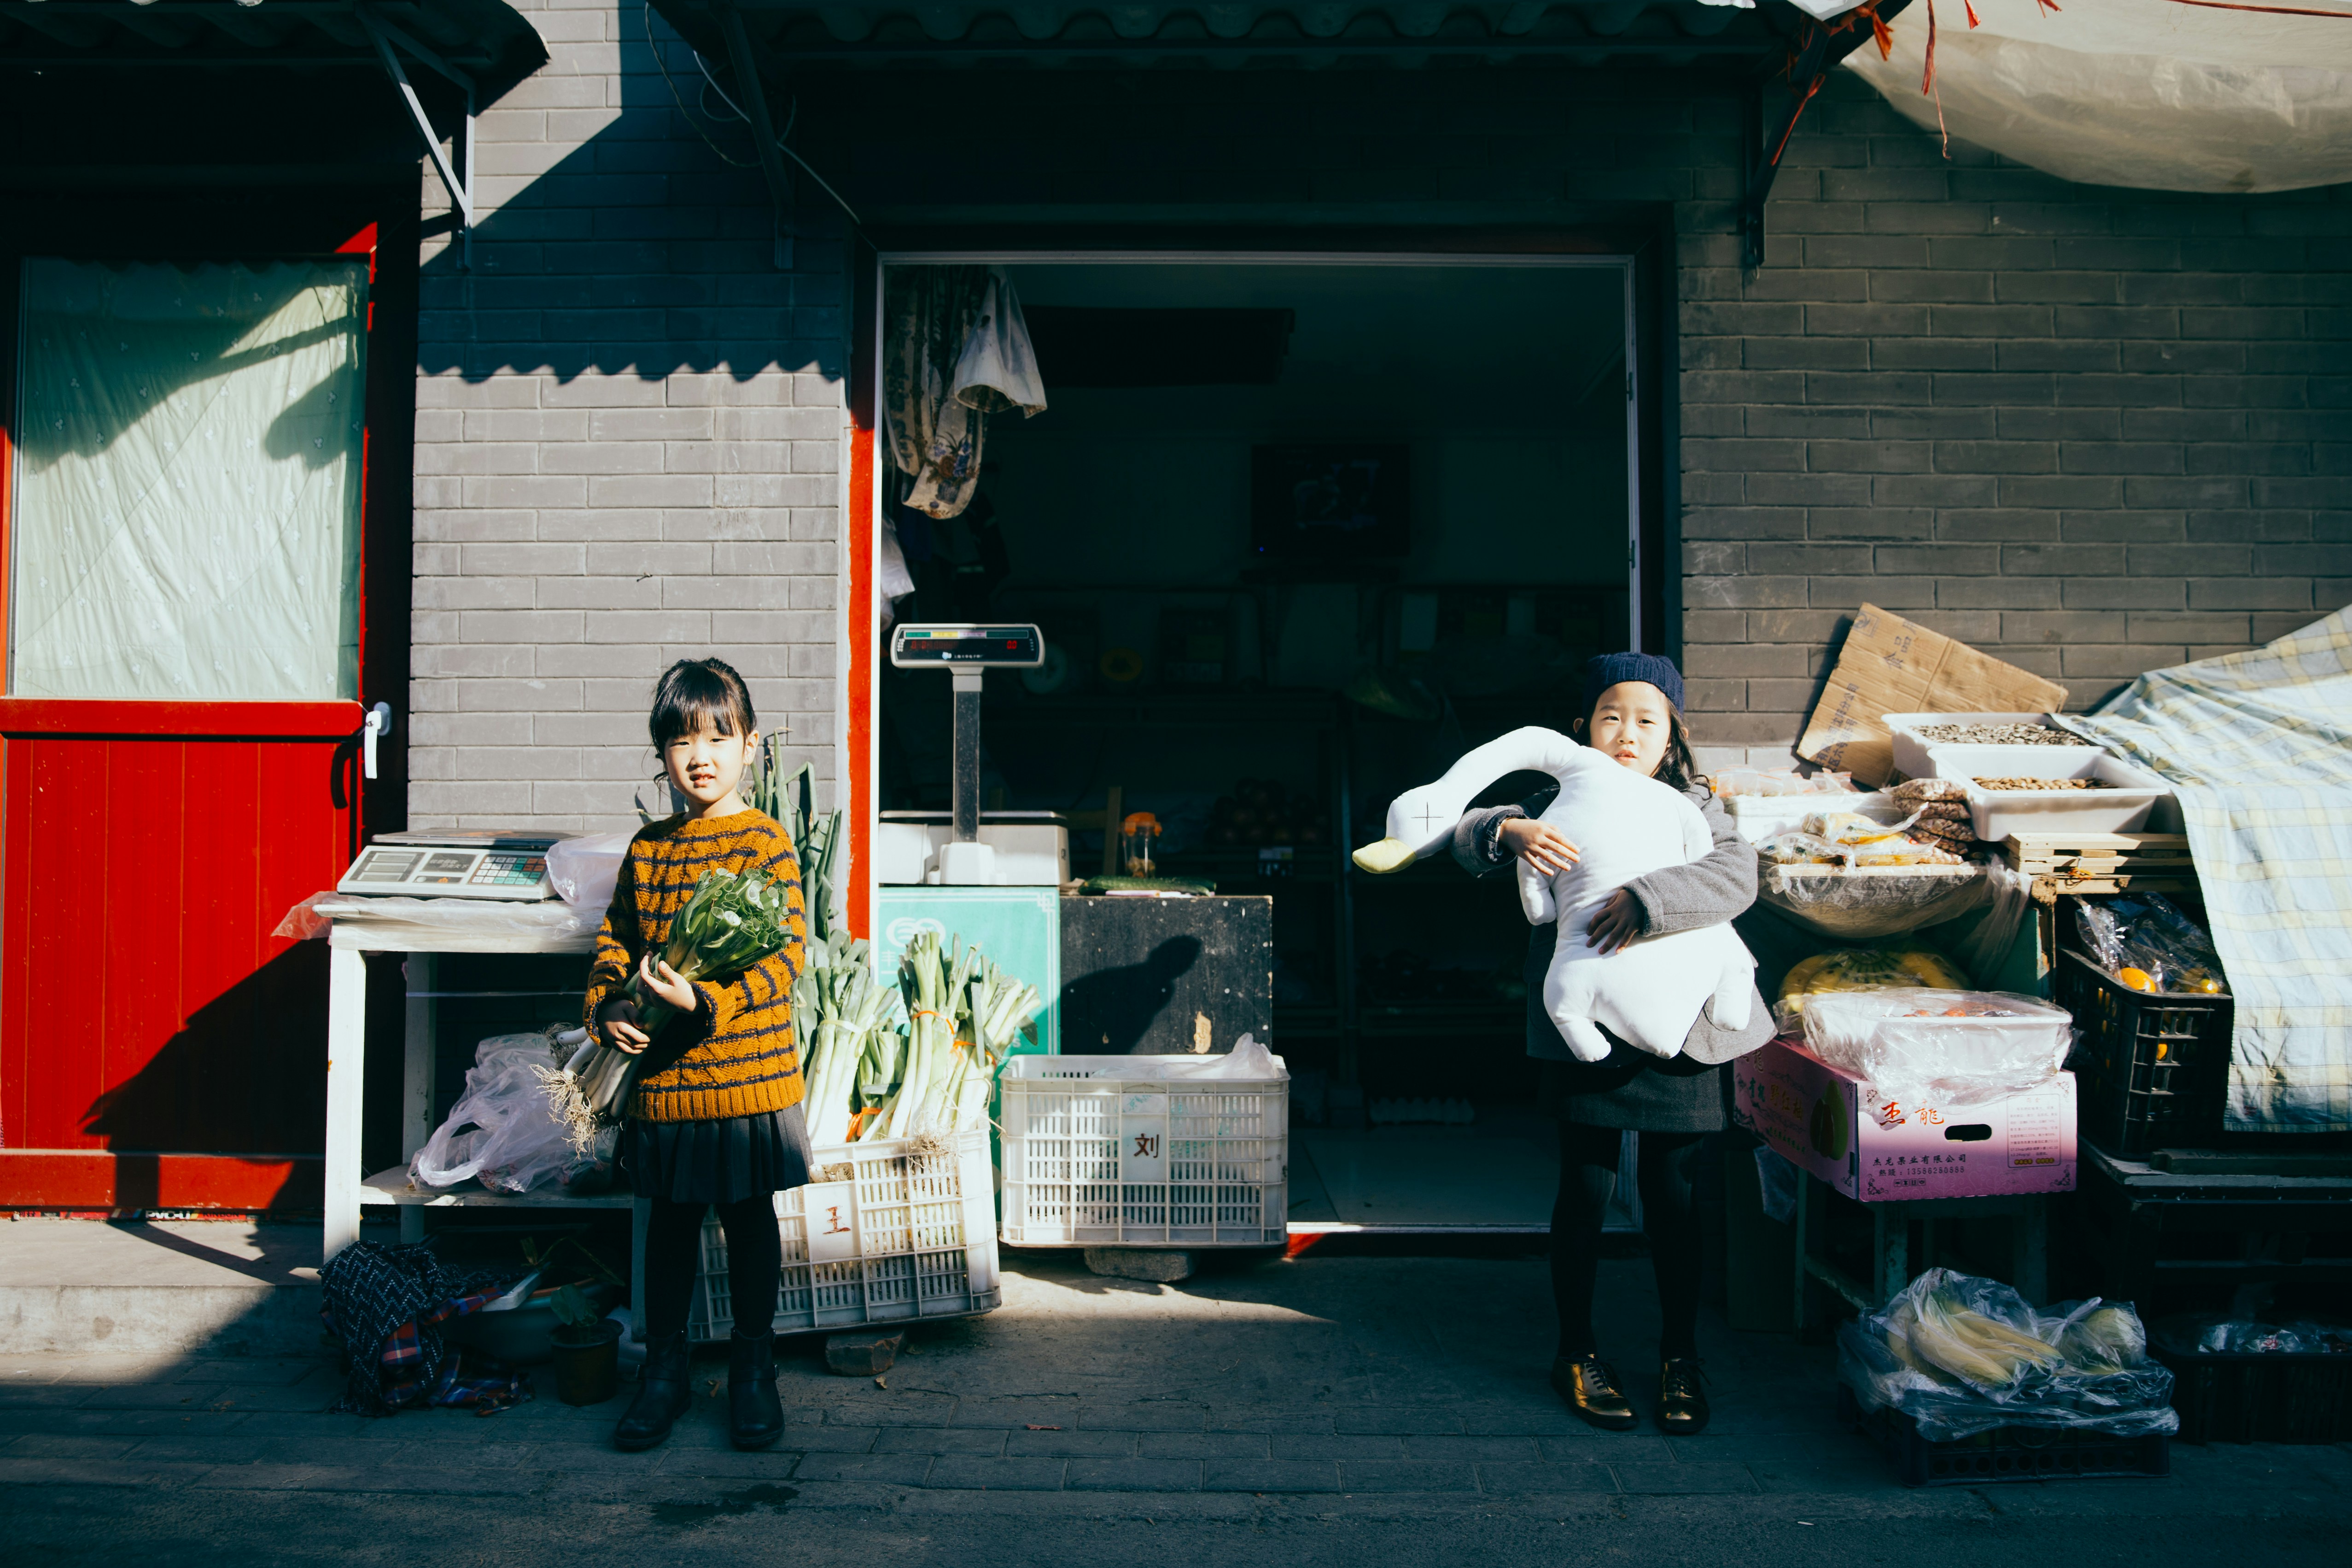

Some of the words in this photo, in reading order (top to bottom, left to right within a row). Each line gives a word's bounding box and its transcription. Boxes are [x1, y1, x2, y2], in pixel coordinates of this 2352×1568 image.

[1133, 1133, 1160, 1159] 刘
[1873, 1154, 1967, 1166] 杰龙果业有限公司
